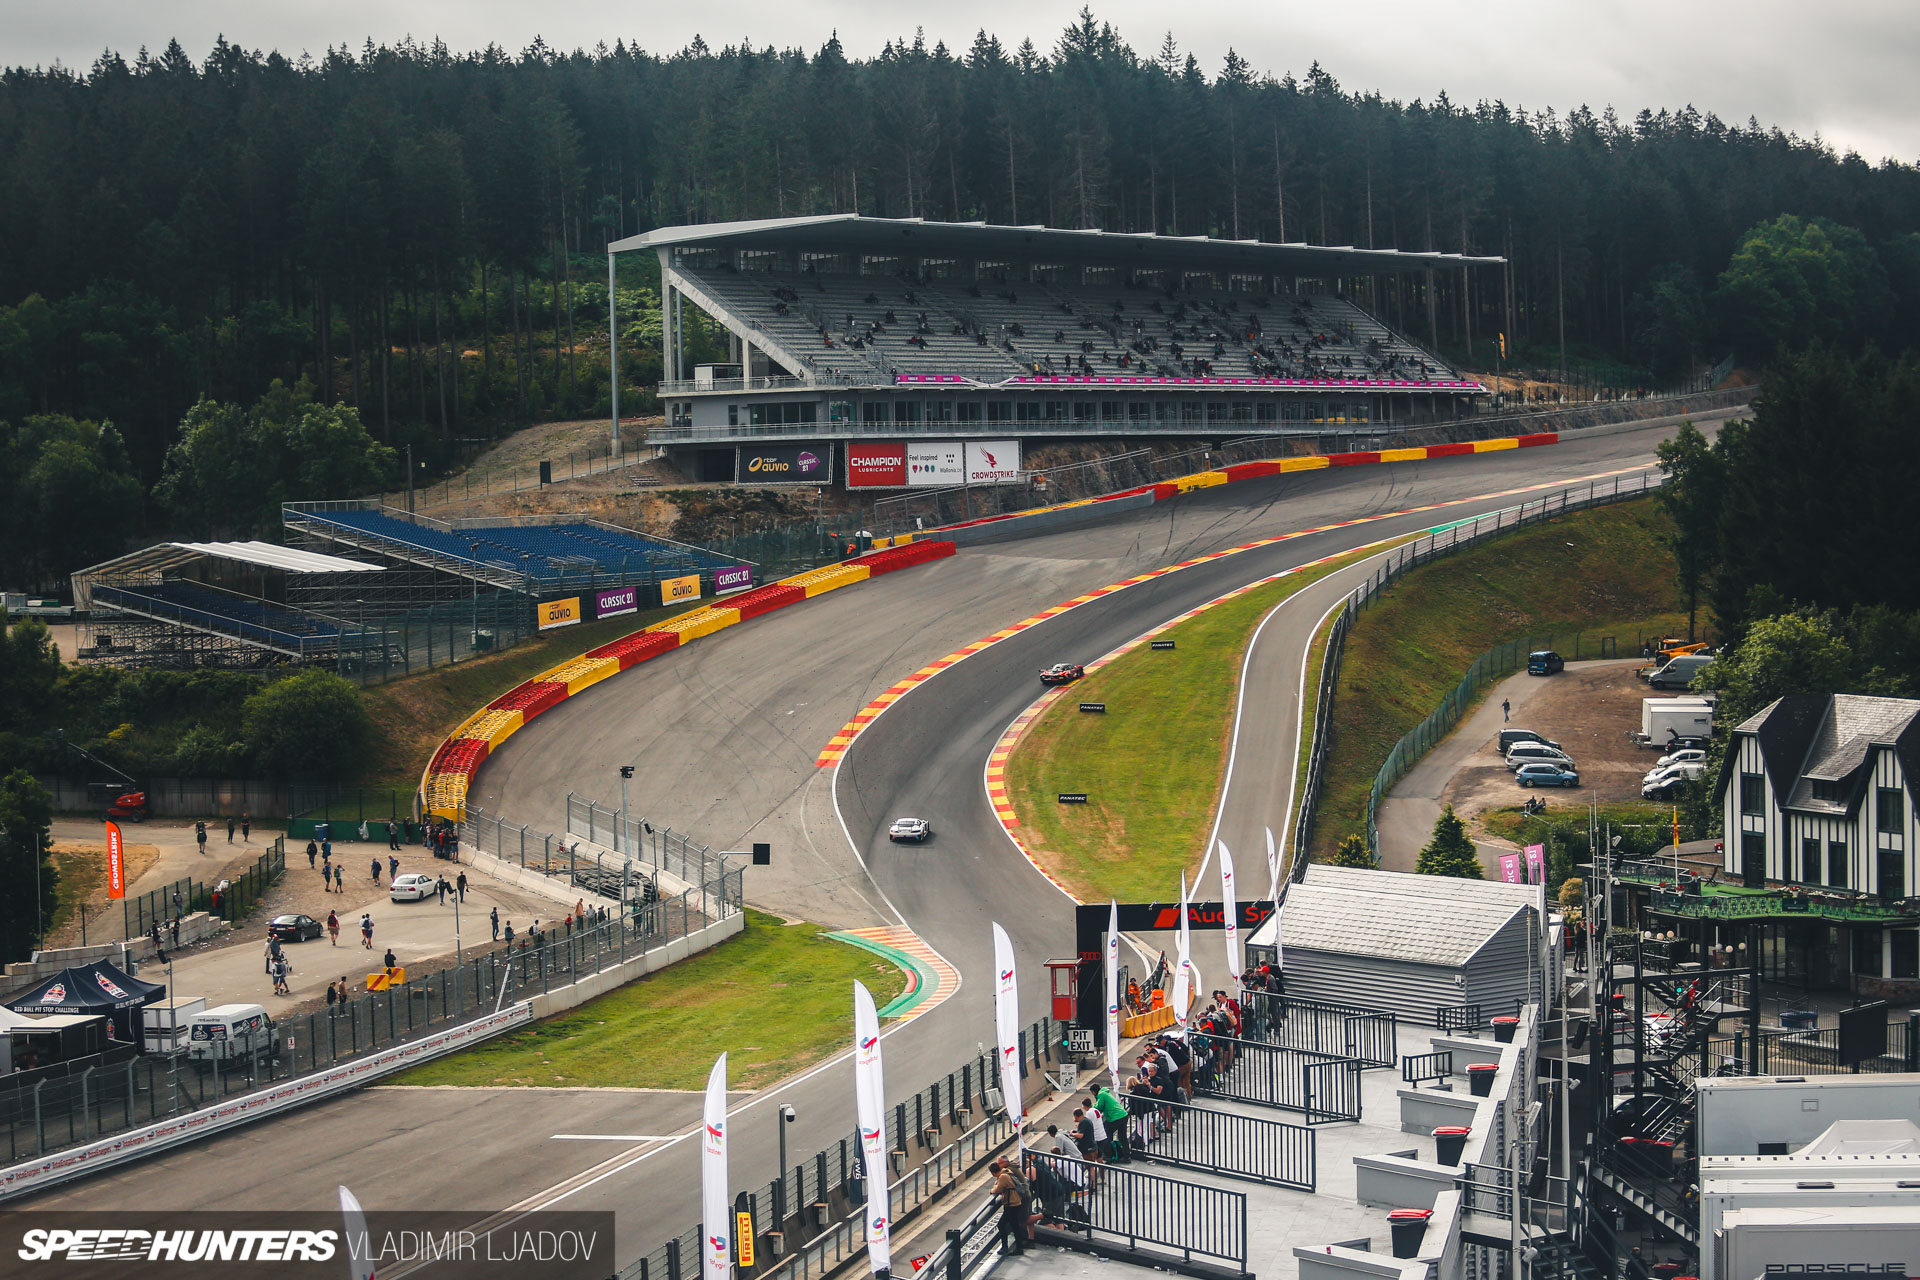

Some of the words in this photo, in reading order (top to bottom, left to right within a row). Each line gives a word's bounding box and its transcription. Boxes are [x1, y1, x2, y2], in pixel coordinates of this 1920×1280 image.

[798, 457, 817, 466] CLASSIC
[851, 457, 901, 467] CHAMPION
[920, 454, 938, 462] inspired
[972, 470, 1014, 480] CROWDSTRIKE
[719, 573, 742, 586] CLASSIC
[742, 570, 749, 580] 21
[601, 594, 626, 608] CLASSIC
[626, 592, 634, 603] 21
[1188, 908, 1224, 923] Au
[1073, 1031, 1088, 1040] PIT
[1071, 1041, 1090, 1050] EXIT
[16, 1168, 40, 1179] TotalEnergies
[740, 1217, 750, 1262] PIRELLI
[1766, 1263, 1906, 1273] PORSCHE
